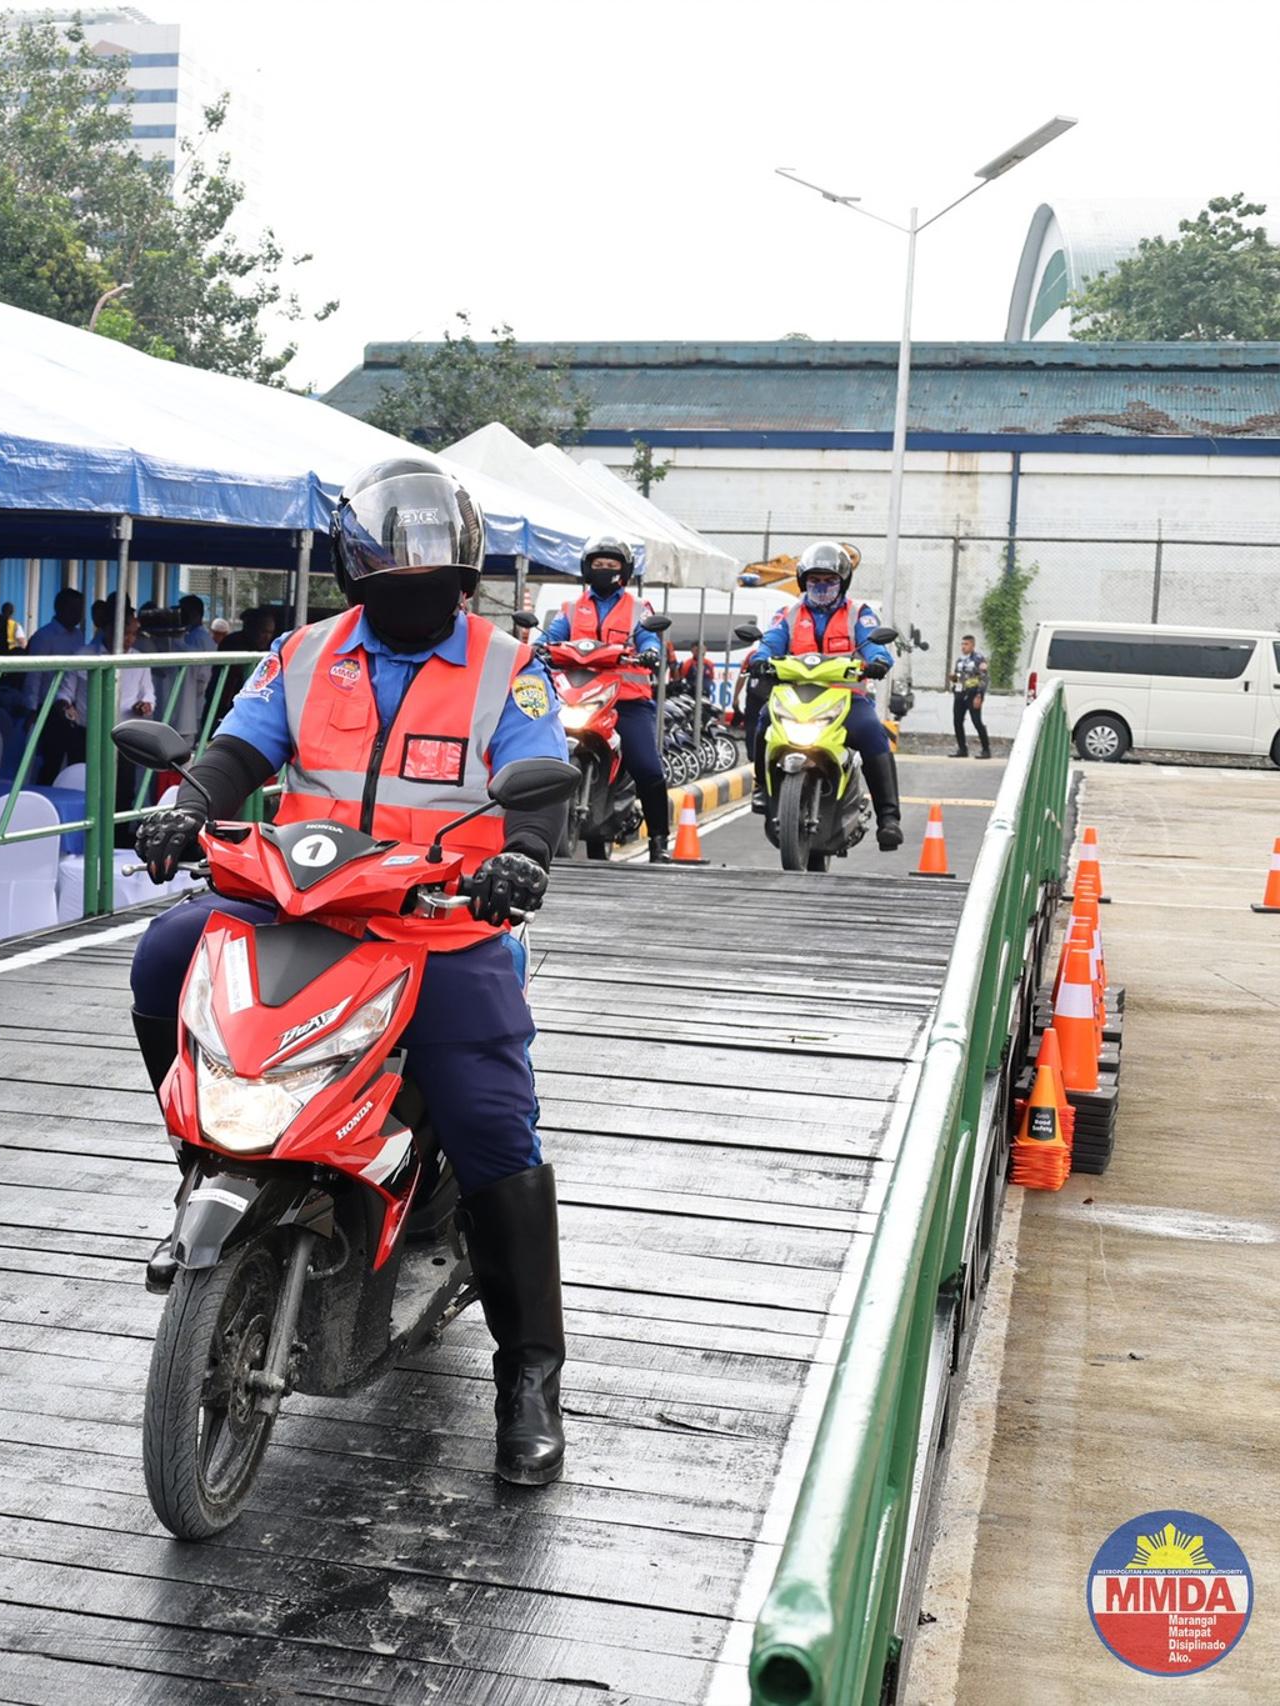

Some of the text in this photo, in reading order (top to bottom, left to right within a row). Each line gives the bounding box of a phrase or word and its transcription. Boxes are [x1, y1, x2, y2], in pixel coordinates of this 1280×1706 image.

[305, 824, 344, 834] HONDA
[306, 841, 323, 861] 1
[335, 1100, 374, 1141] HONDA
